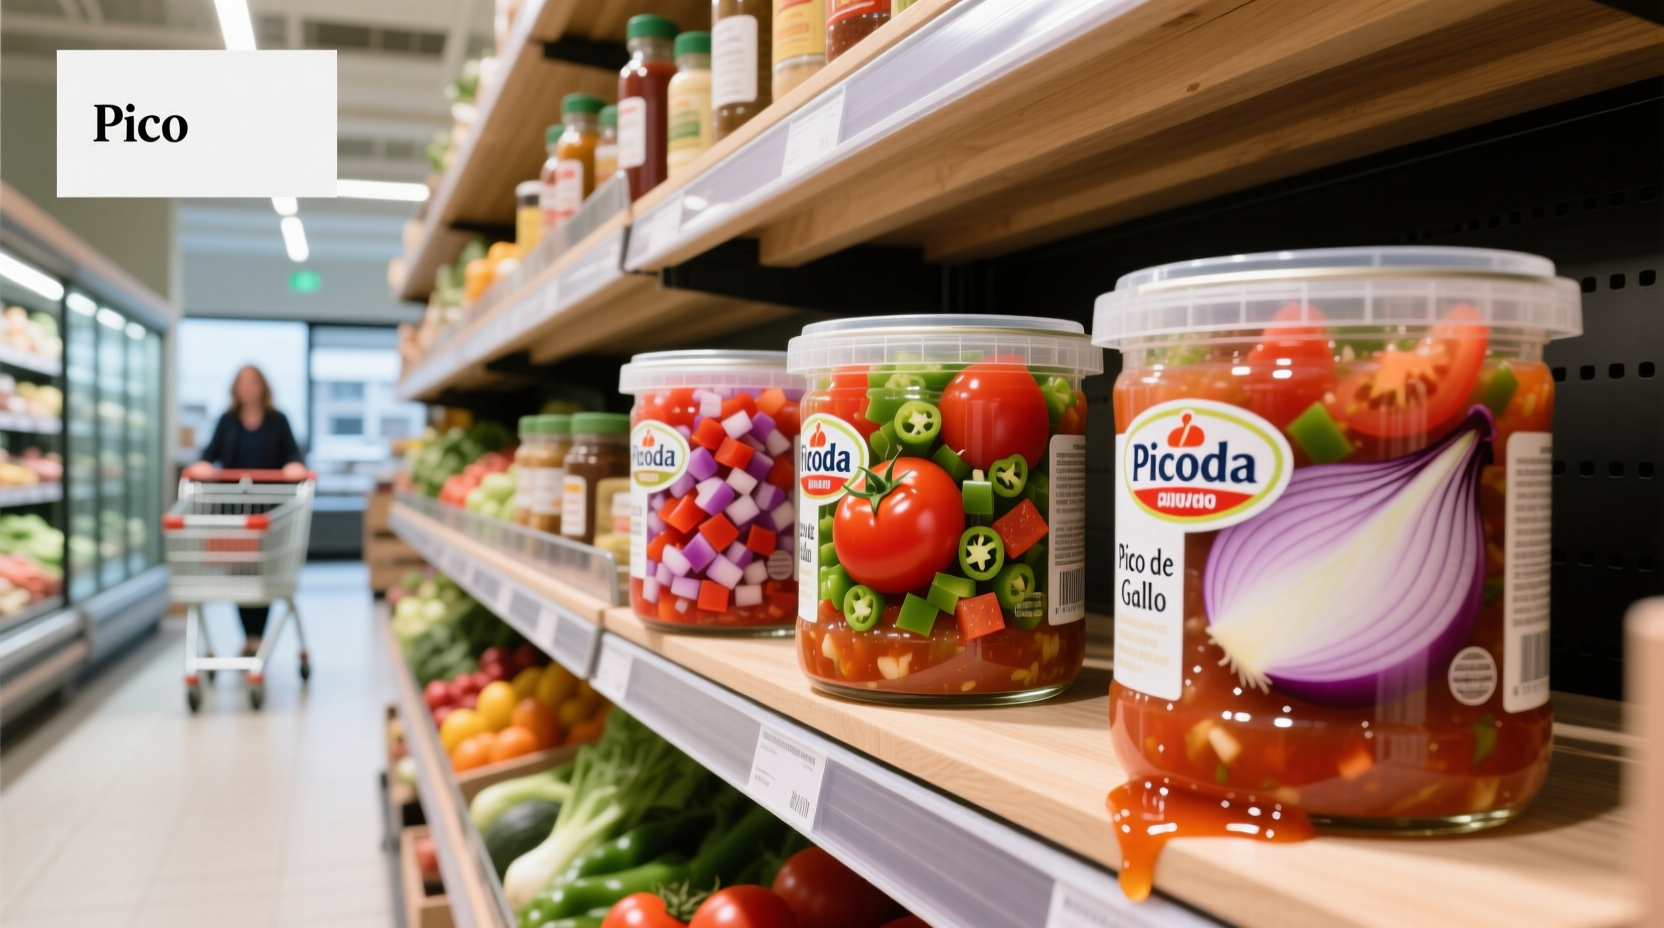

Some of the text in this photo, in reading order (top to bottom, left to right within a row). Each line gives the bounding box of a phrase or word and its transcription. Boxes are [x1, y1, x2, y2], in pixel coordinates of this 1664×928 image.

[1133, 441, 1258, 483] Picoda
[1119, 543, 1174, 577] Pico de
[1121, 579, 1167, 613] Gallo
